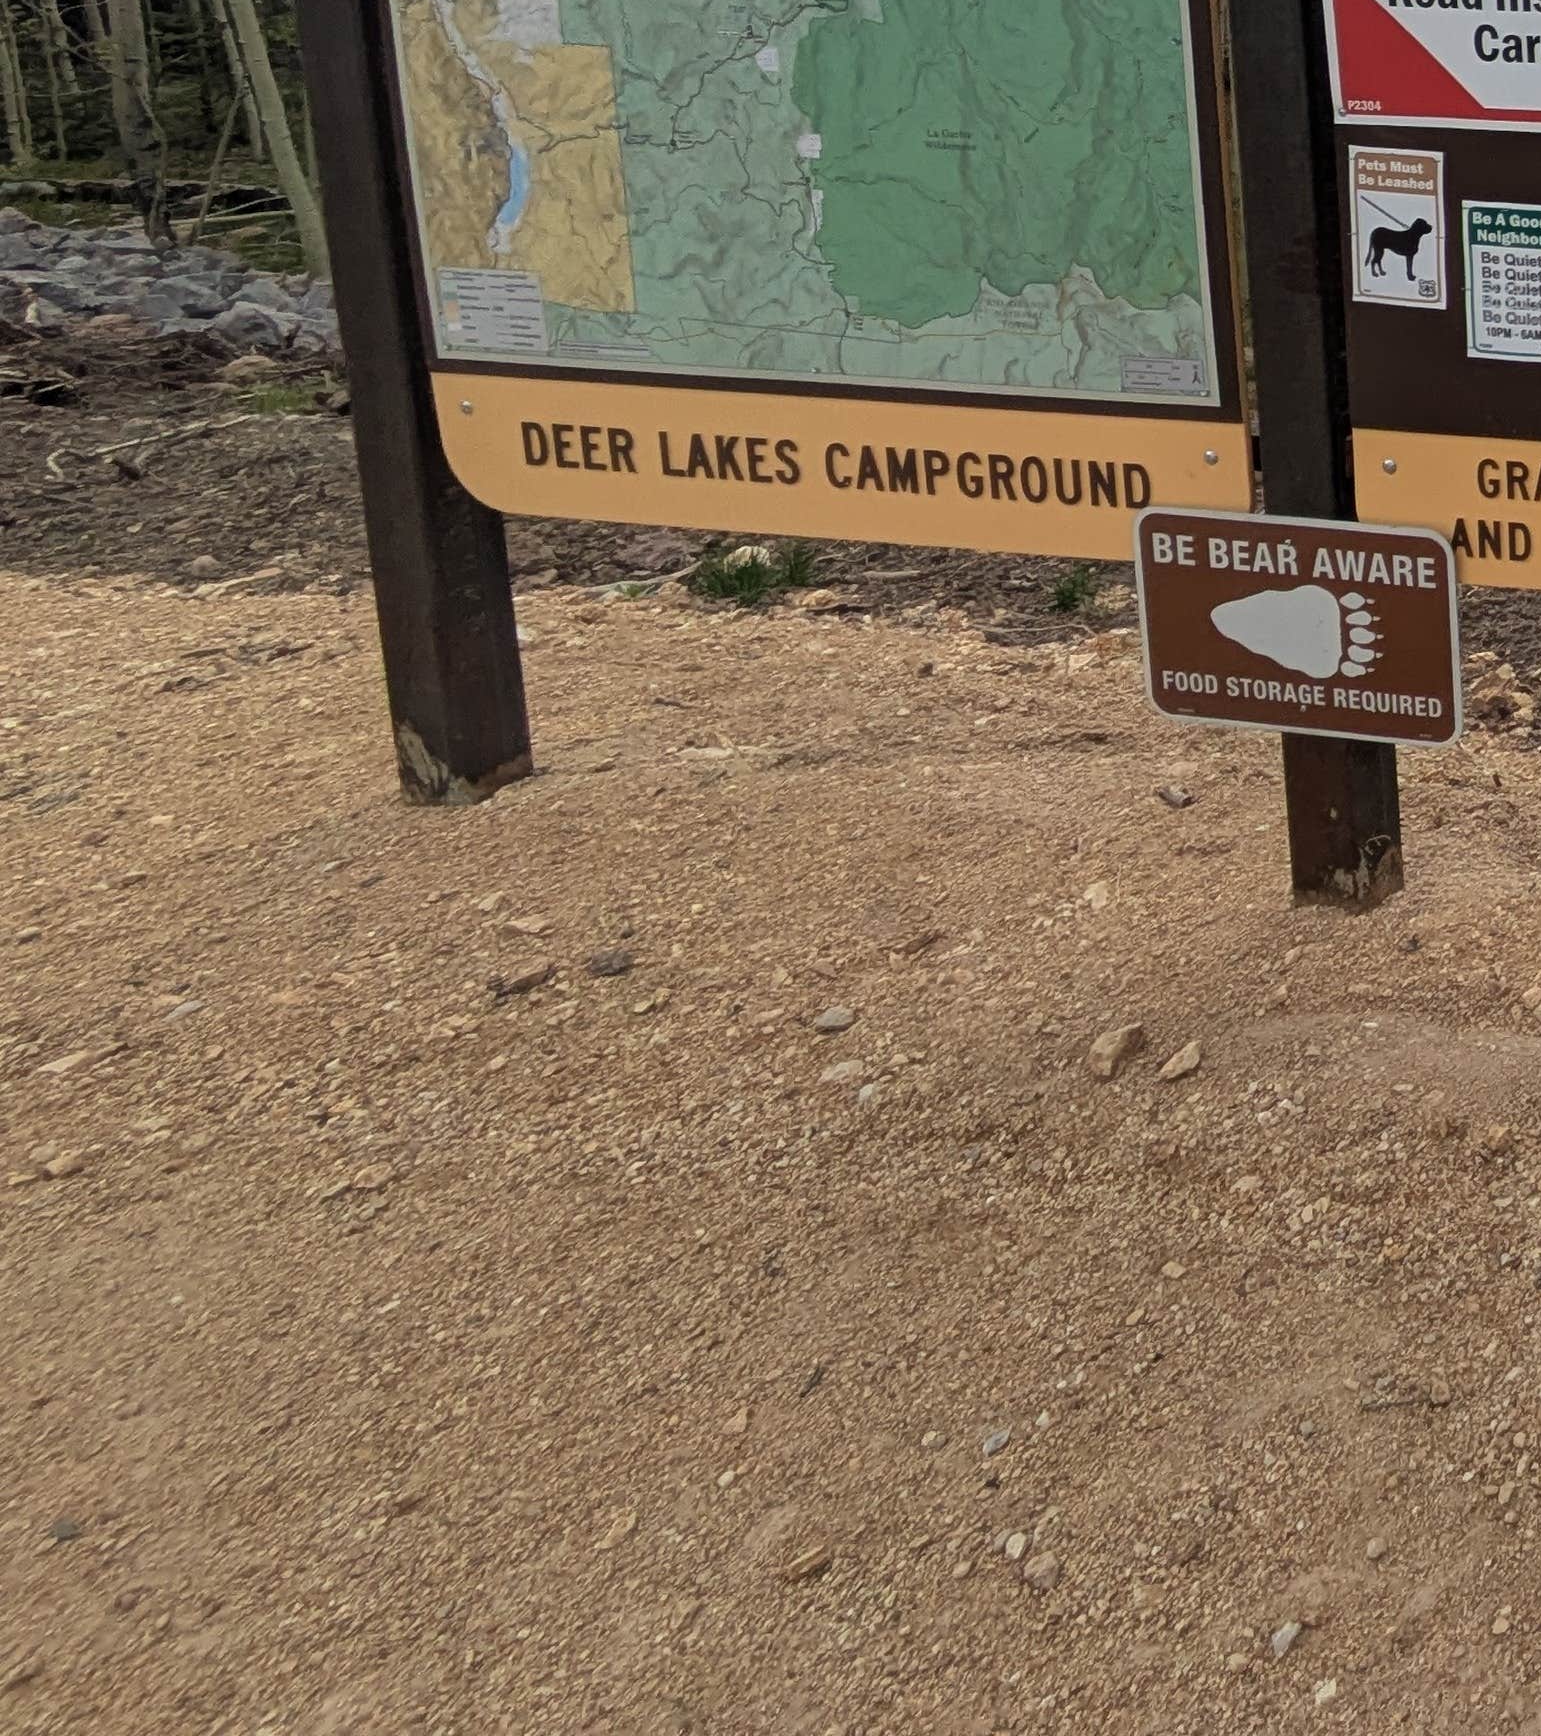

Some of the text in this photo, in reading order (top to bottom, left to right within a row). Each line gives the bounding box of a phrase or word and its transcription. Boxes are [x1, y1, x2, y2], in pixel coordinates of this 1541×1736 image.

[1348, 100, 1381, 112] P2304
[1358, 159, 1424, 174] Pets Must
[1358, 174, 1434, 190] Be Leashed
[1472, 212, 1492, 224] Be
[1495, 214, 1505, 225] A
[1481, 252, 1499, 265] Be
[1482, 267, 1500, 279] Be
[1483, 310, 1501, 323] Be
[1486, 327, 1512, 339] 10PM
[521, 420, 1151, 510] DEER LAKES CAMPGROUND
[1451, 518, 1532, 561] AND
[1151, 532, 1437, 589] BE BEAR AWARE
[1162, 670, 1442, 718] FOOD STORAGE REQUIRED
